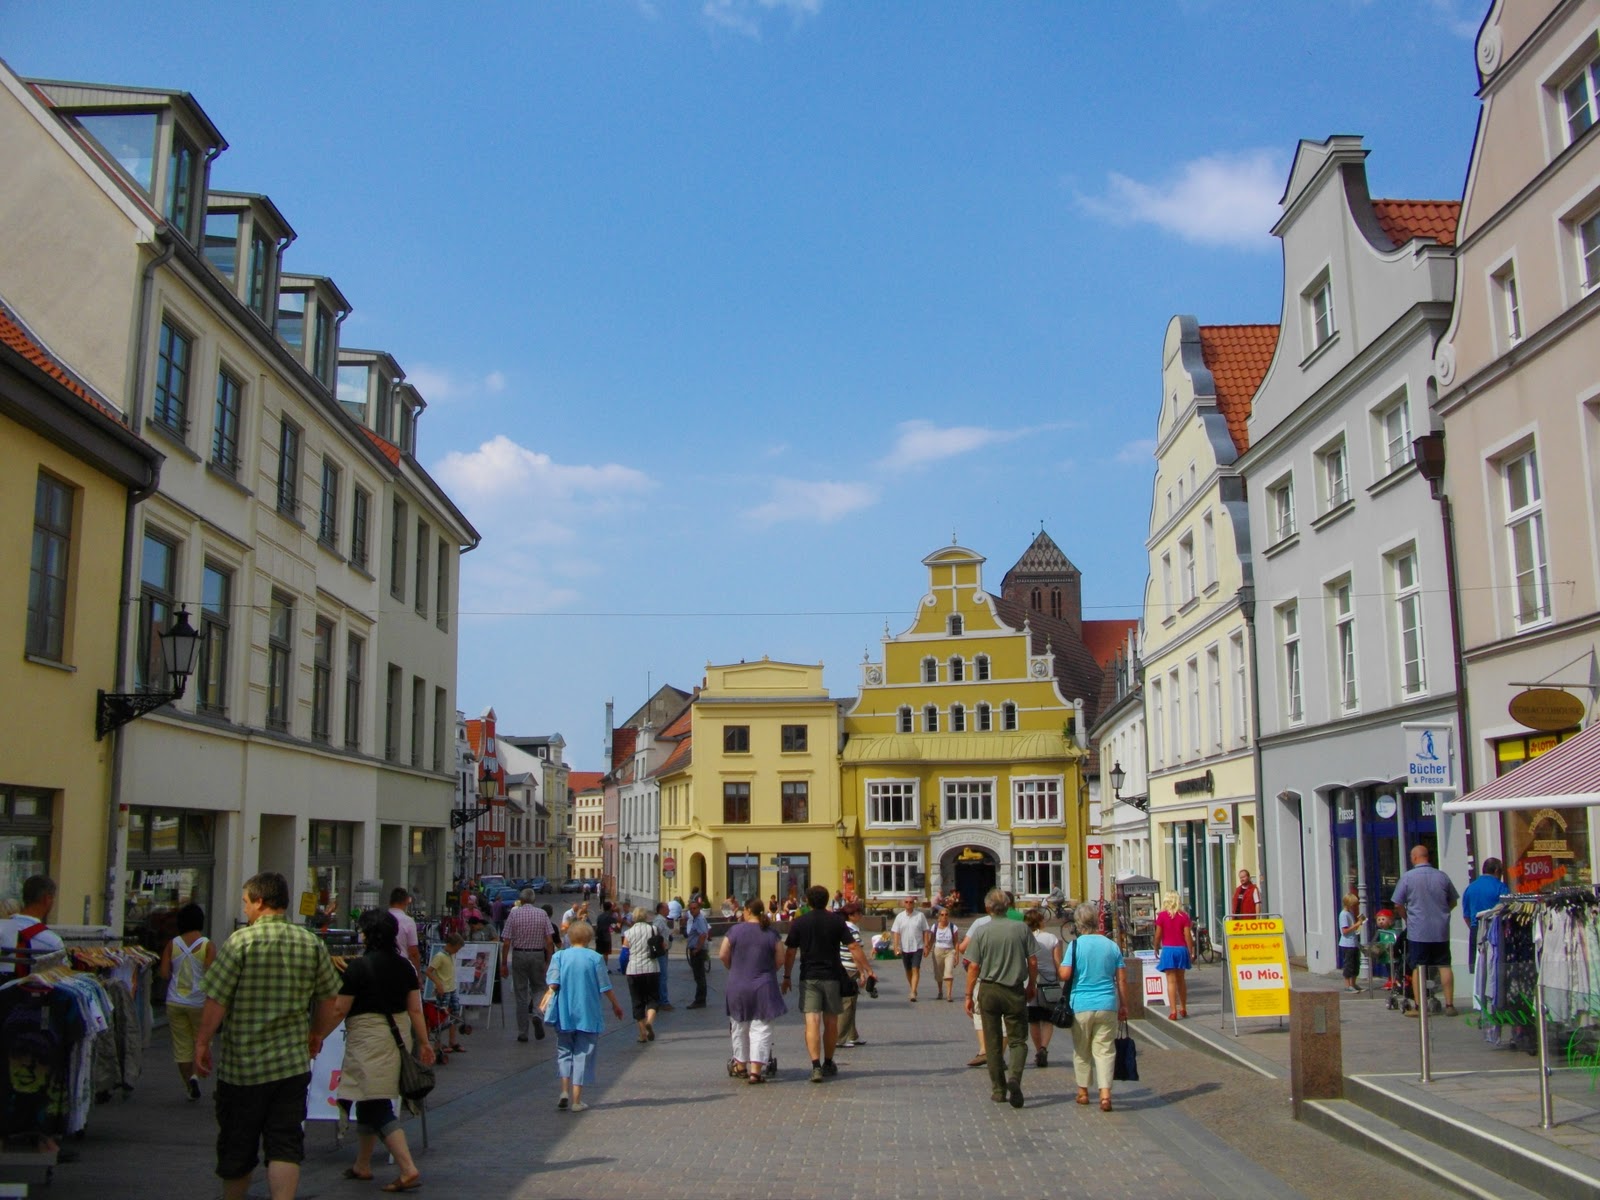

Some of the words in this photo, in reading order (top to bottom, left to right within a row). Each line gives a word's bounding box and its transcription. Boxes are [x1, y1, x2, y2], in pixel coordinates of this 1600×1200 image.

[1537, 739, 1556, 752] LOTTO
[1409, 763, 1447, 775] Bücher
[1420, 776, 1444, 784] Presse
[1339, 807, 1354, 820] Presse
[1523, 861, 1550, 876] 50%
[1245, 922, 1276, 931] LOTTO
[1239, 970, 1252, 980] 10
[1258, 969, 1284, 980] Mio.
[1147, 978, 1162, 994] Bild
